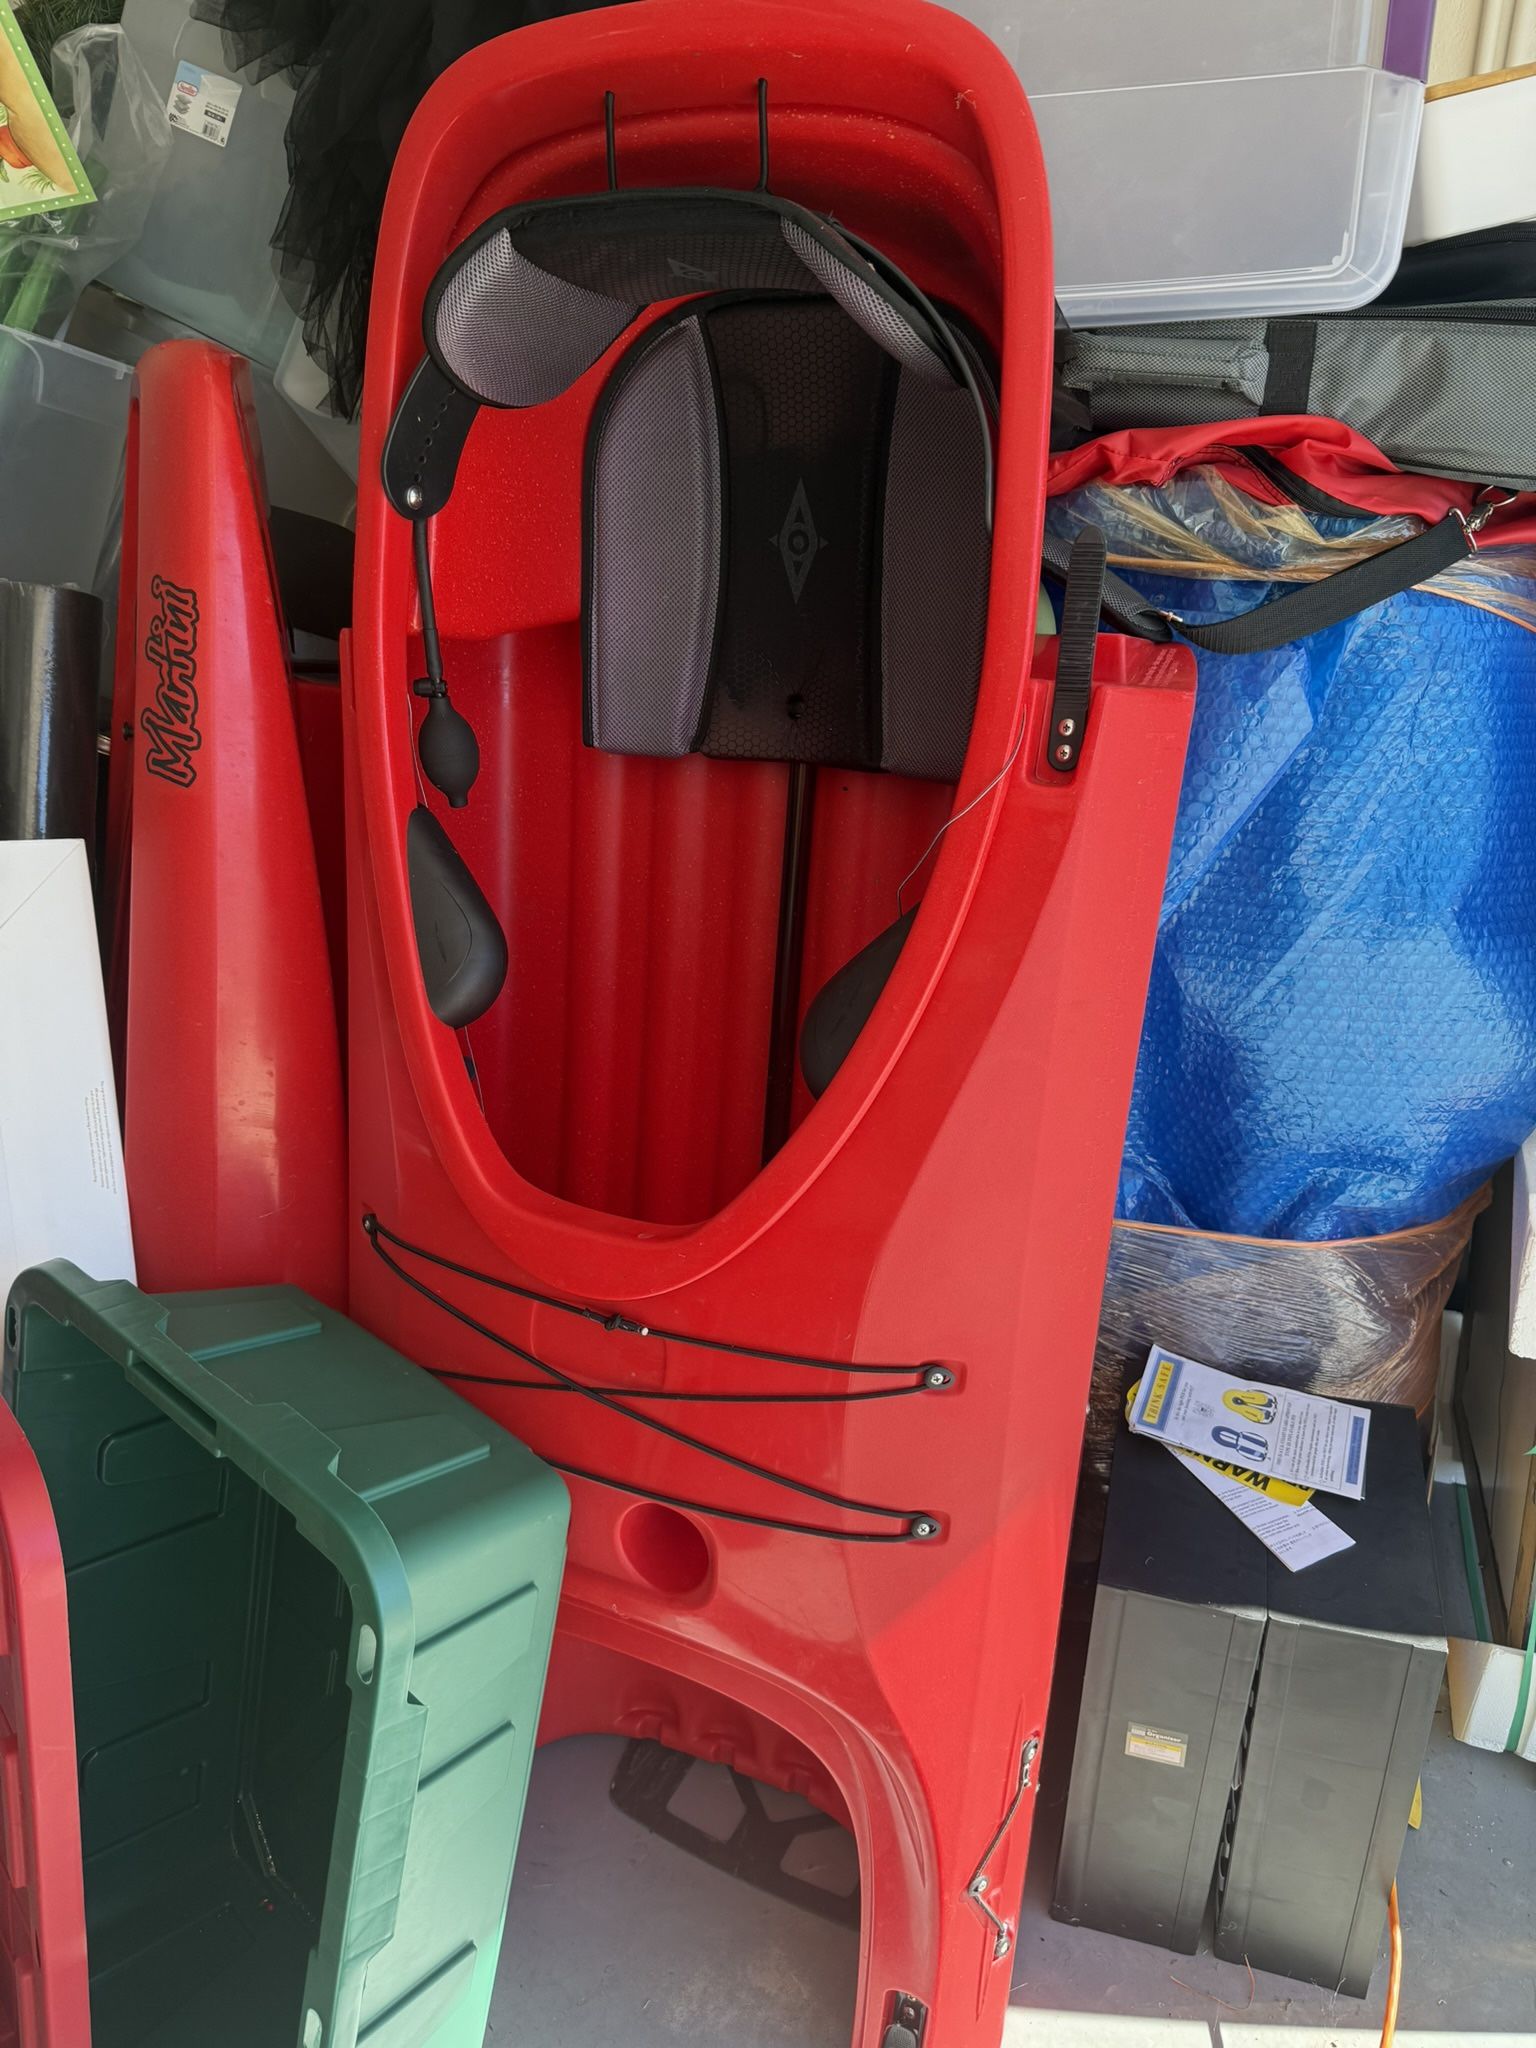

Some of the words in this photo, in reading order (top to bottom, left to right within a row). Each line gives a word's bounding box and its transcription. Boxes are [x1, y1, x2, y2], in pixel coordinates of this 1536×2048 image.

[141, 575, 201, 788] Martini
[1147, 1394, 1162, 1419] THINK
[1158, 1363, 1173, 1393] SAFE
